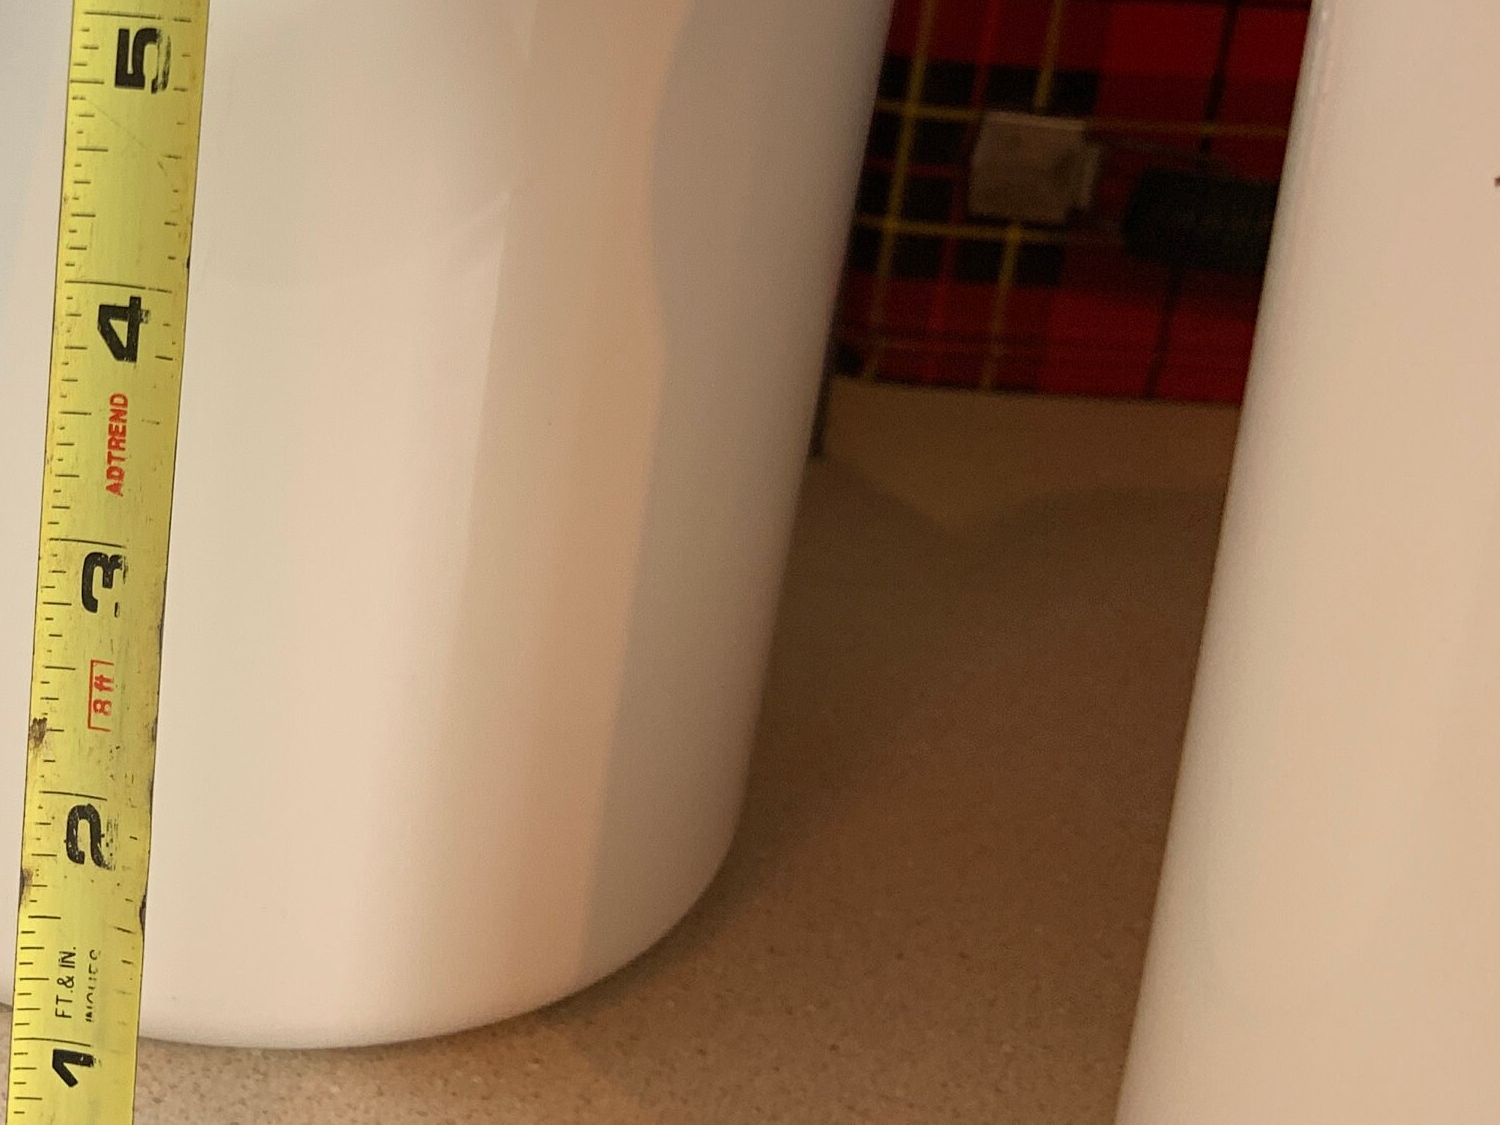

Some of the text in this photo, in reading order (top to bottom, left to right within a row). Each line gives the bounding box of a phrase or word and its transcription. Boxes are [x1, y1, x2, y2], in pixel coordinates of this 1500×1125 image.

[114, 26, 172, 94] 5
[96, 295, 152, 364] 4
[105, 392, 130, 497] ADTREND
[80, 551, 128, 617] 3
[64, 803, 116, 872] 2
[51, 1047, 96, 1088] 1
